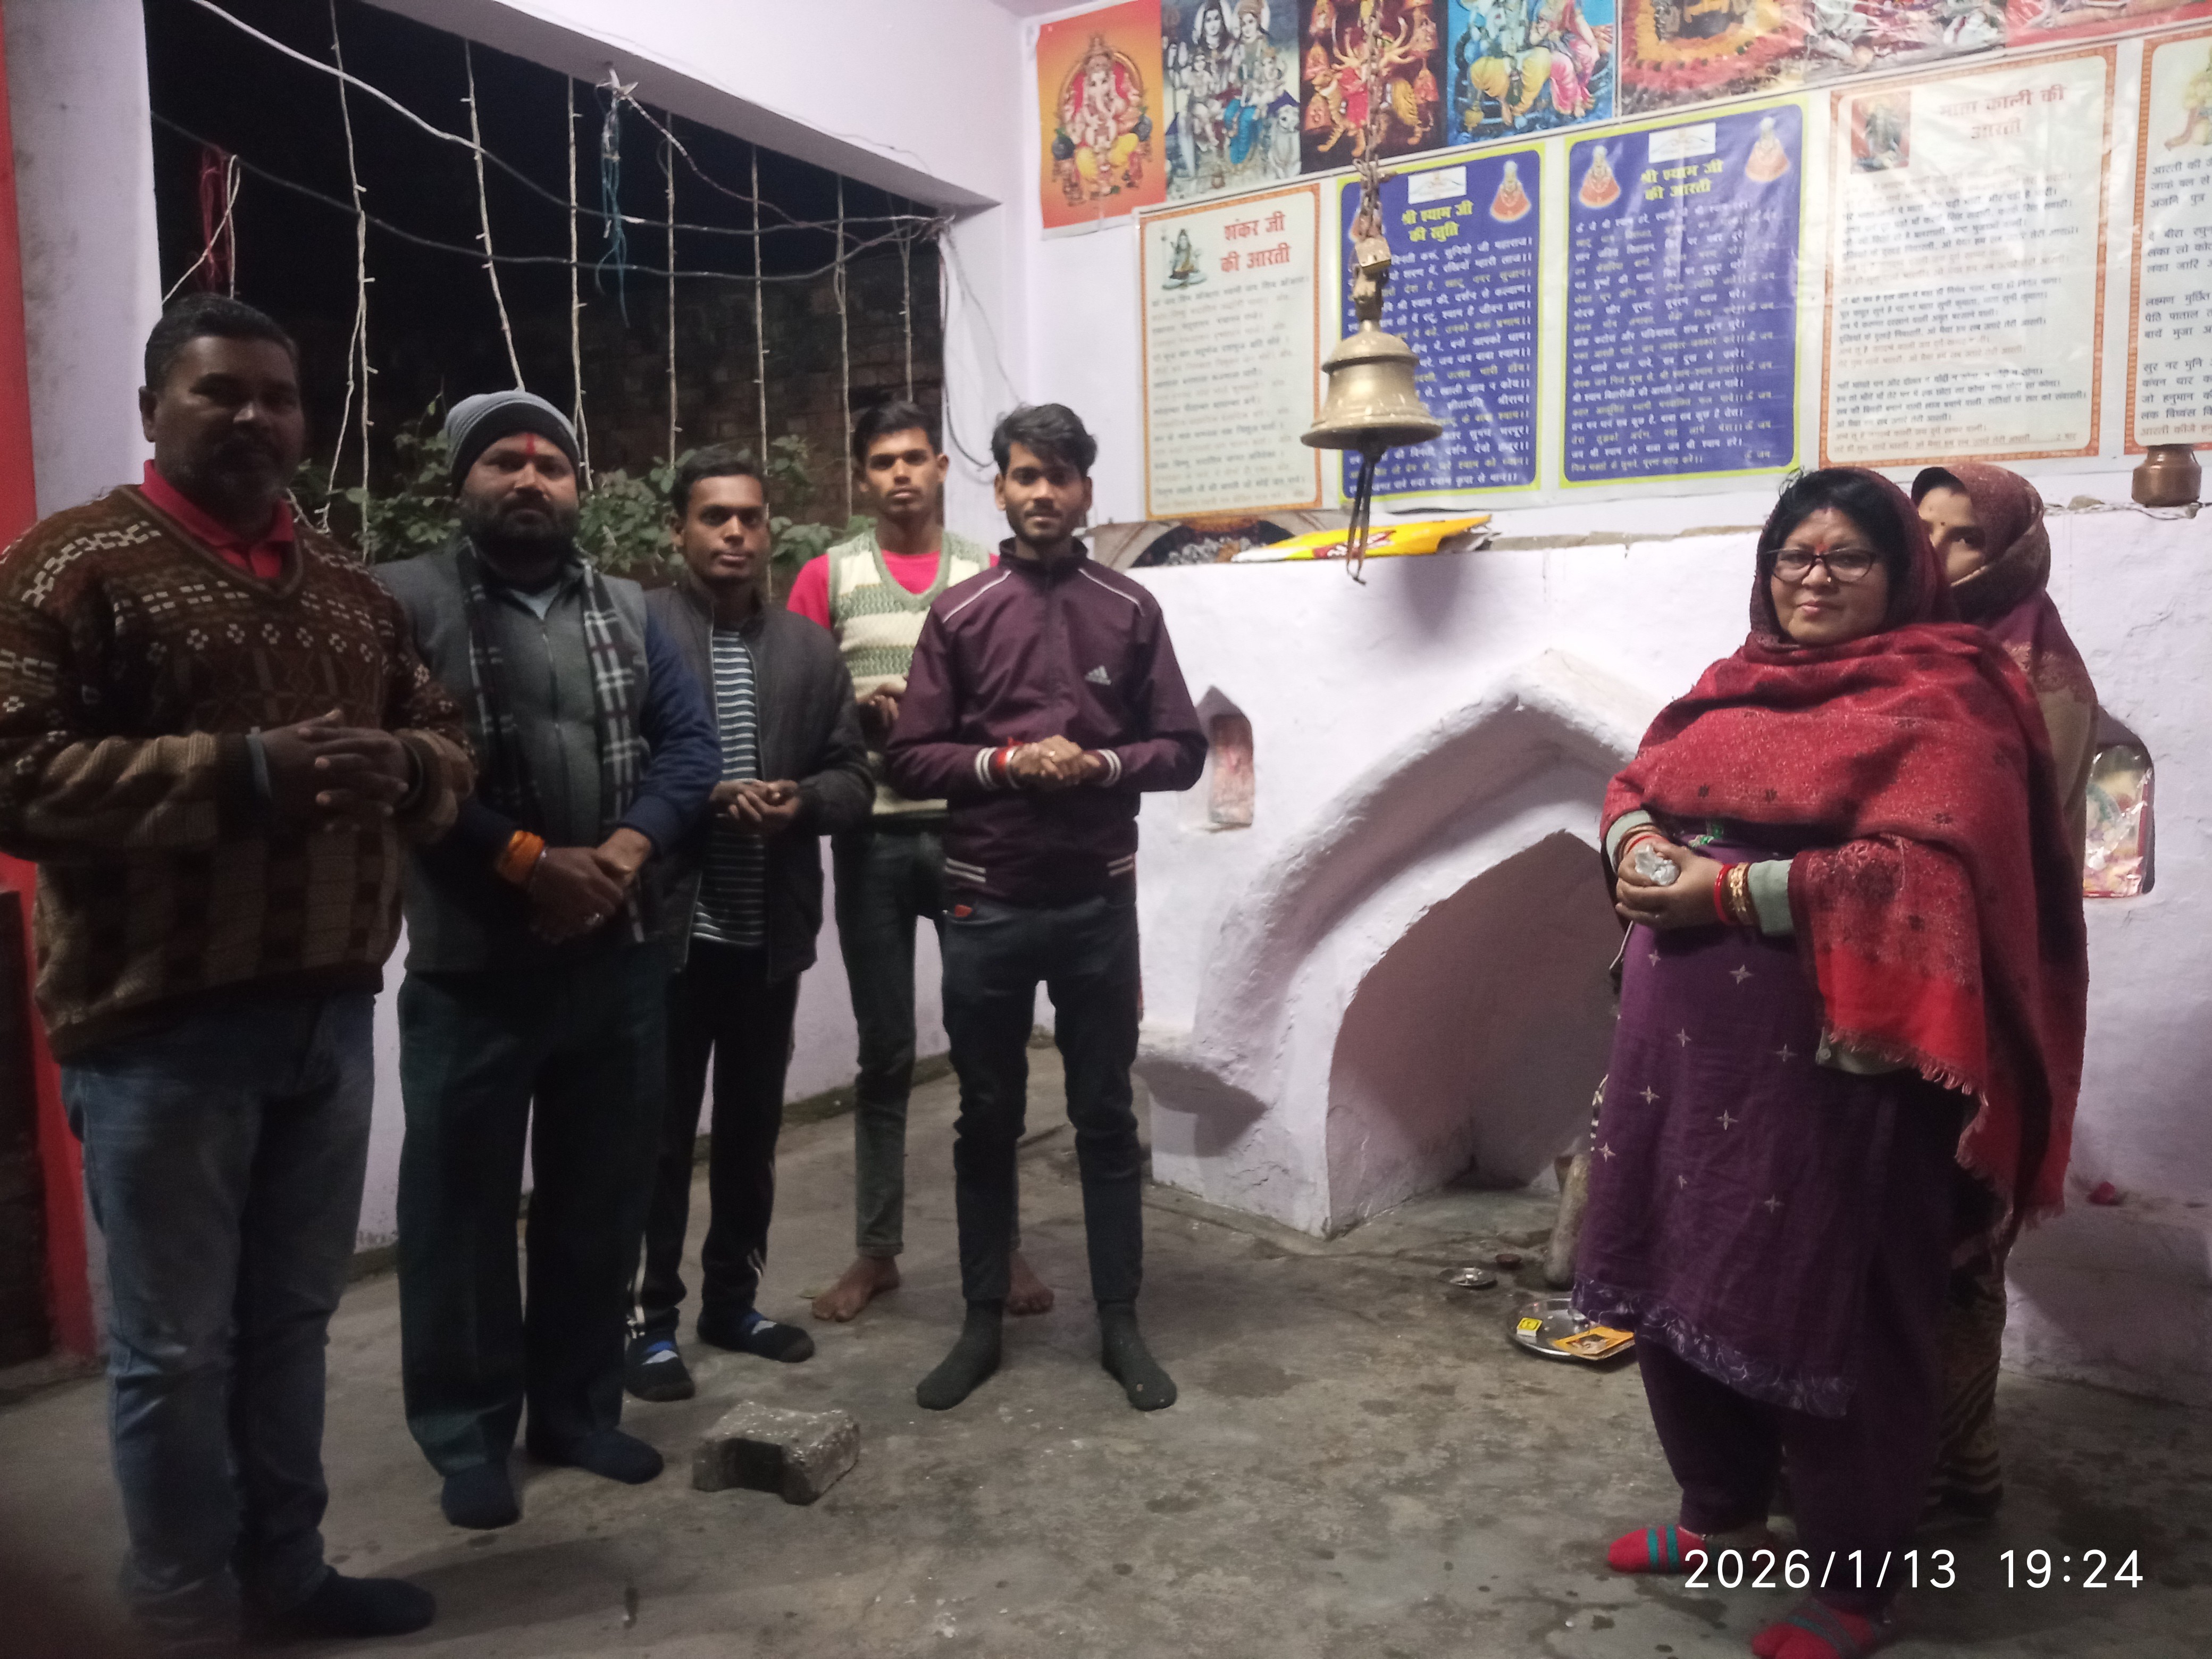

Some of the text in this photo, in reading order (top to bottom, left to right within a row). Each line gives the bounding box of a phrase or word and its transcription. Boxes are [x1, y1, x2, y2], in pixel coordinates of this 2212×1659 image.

[1985, 89, 2033, 110] काली
[2040, 83, 2067, 102] की
[2152, 161, 2182, 175] आरती
[2187, 158, 2201, 170] की
[1670, 178, 1712, 197] आरती
[1224, 211, 1285, 240] शंकर जी
[1220, 242, 1291, 273] की आरती
[2169, 310, 2199, 320] पाताल
[2165, 361, 2178, 370] नर
[2163, 392, 2193, 405] हनुमान
